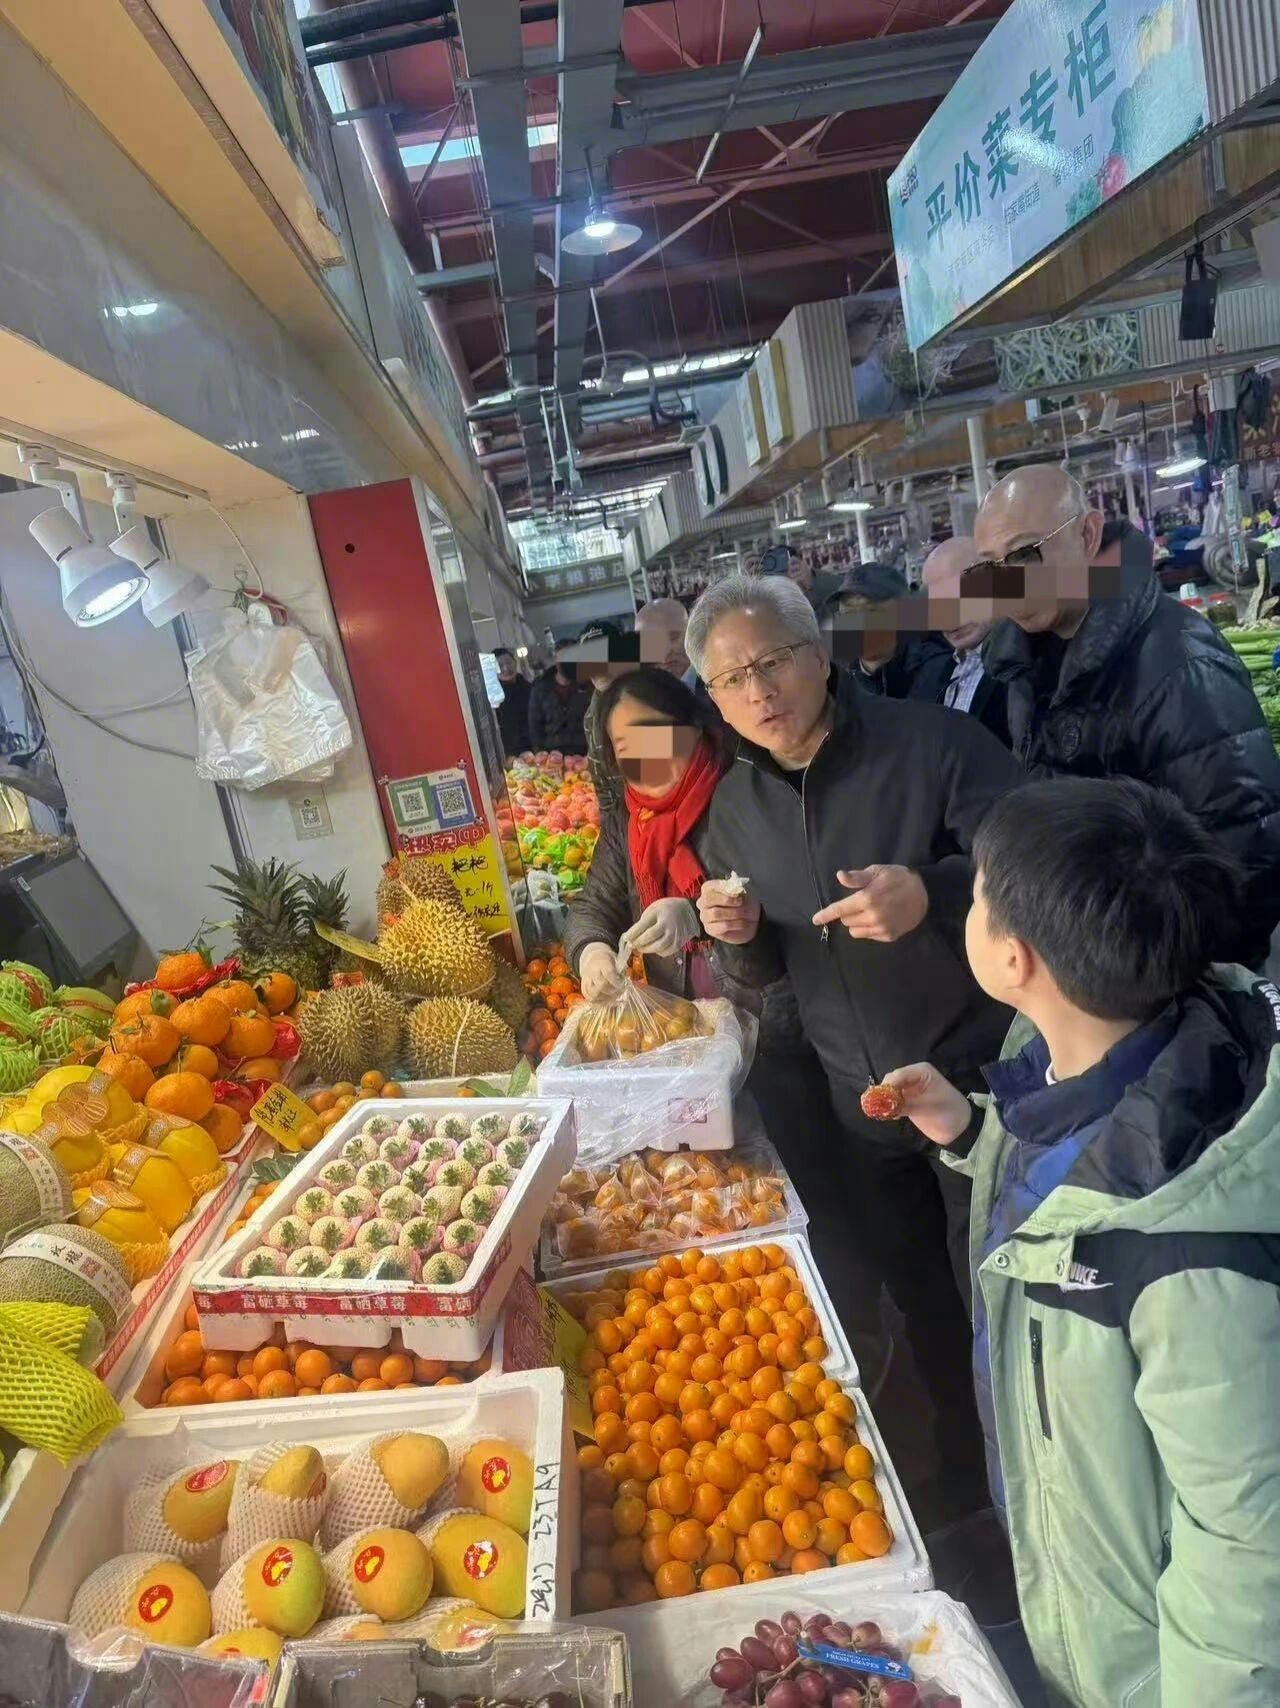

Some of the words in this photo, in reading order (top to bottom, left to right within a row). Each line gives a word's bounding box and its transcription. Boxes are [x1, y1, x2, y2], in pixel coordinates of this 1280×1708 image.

[924, 0, 1116, 250] 平价菜专柜
[1070, 1262, 1099, 1286] NIKE
